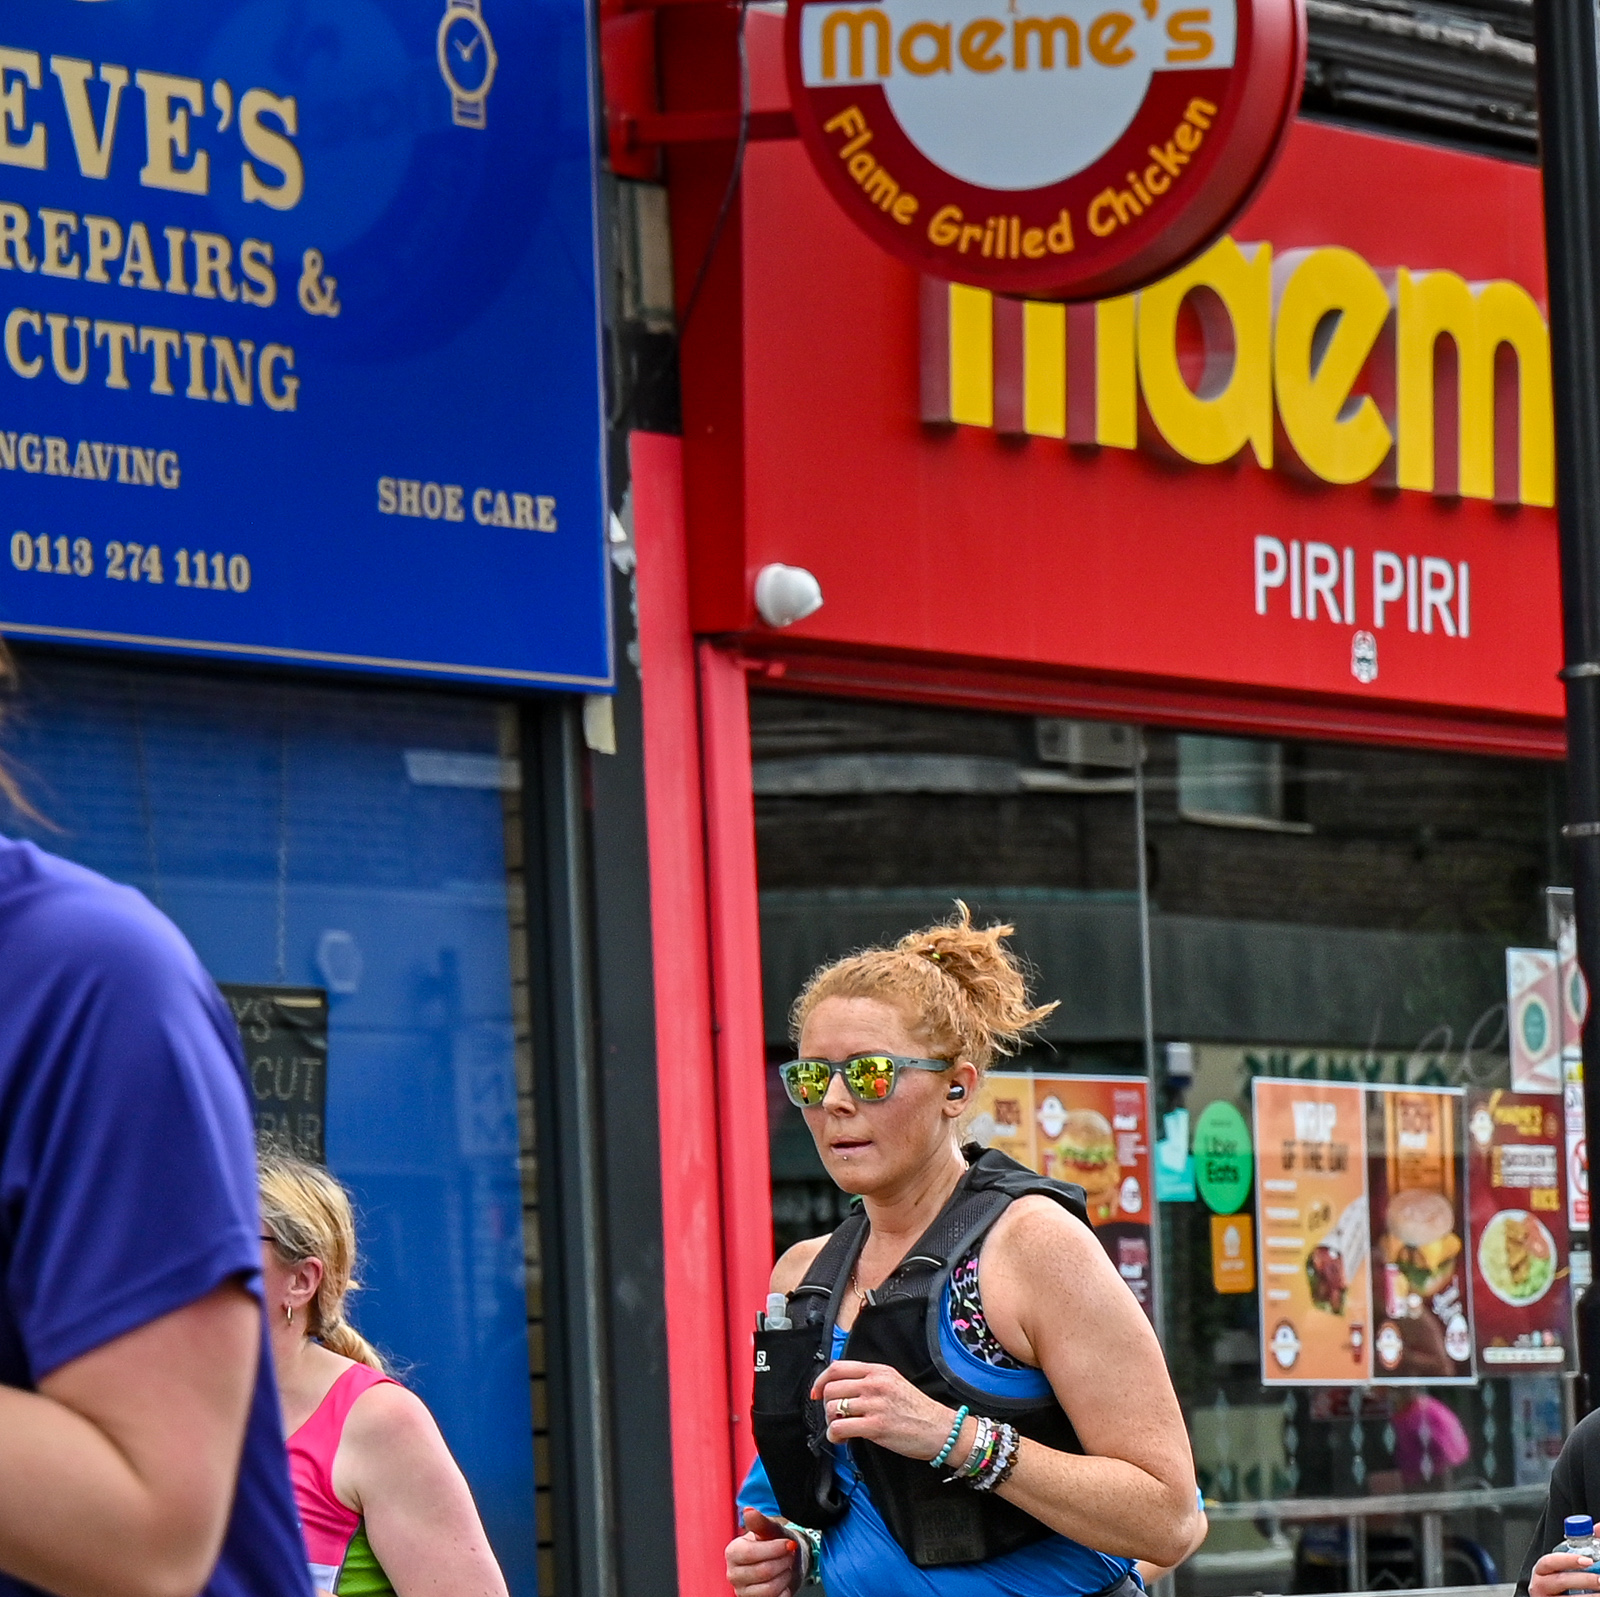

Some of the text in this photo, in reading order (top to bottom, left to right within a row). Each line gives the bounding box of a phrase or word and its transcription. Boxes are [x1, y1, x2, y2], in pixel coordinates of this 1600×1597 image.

[823, 97, 1218, 260] Flame Grilled Chicken
[0, 202, 340, 317] REPAIRS &
[4, 308, 301, 412] CUTTING
[377, 476, 557, 533] SHOE CARE
[11, 530, 250, 593] 0113 274 1110
[1254, 535, 1471, 637] PIRI PIRI
[251, 1055, 322, 1101] CUT
